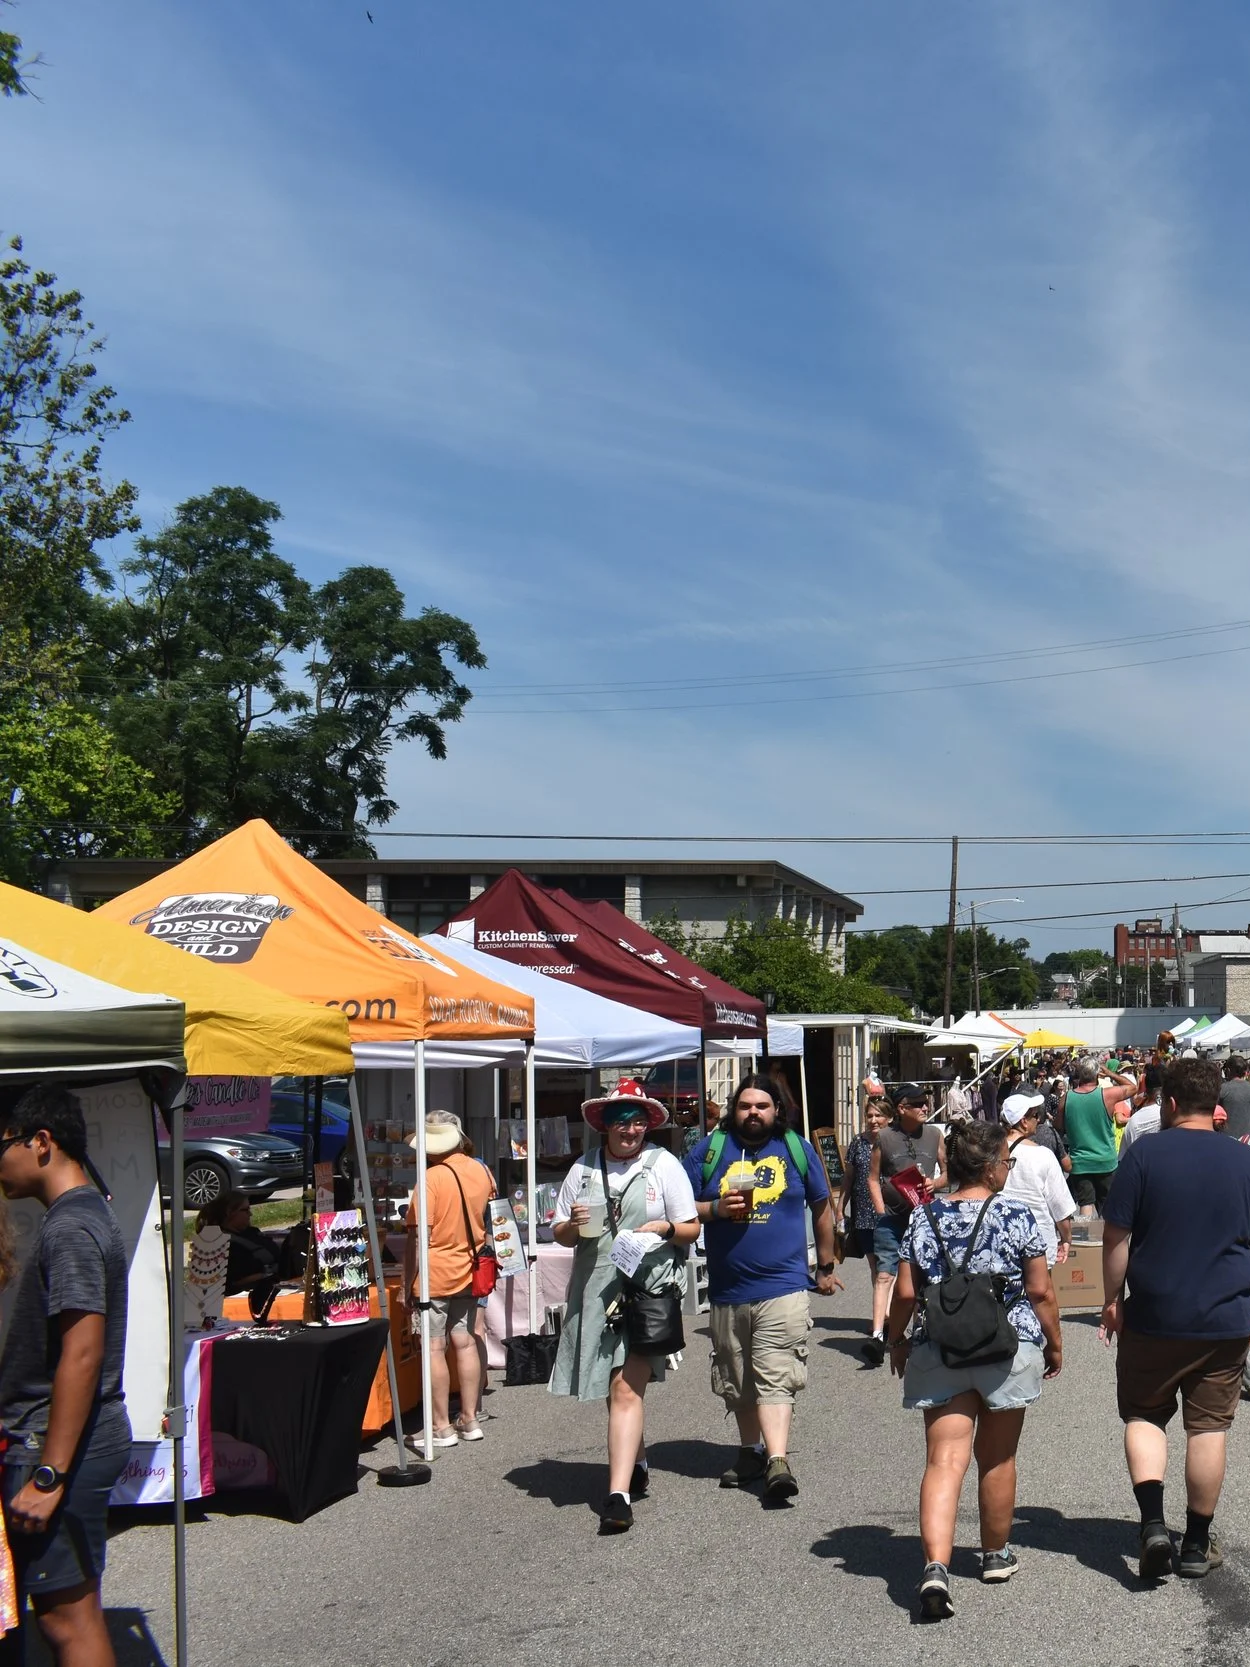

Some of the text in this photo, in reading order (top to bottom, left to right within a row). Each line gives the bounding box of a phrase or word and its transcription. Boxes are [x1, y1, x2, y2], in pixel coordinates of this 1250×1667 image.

[129, 894, 295, 925] American
[150, 920, 263, 935] DESIGN
[187, 934, 212, 942] and
[478, 930, 576, 943] KitchenSaver
[171, 943, 239, 957] UILD
[206, 1076, 246, 1107] Candle
